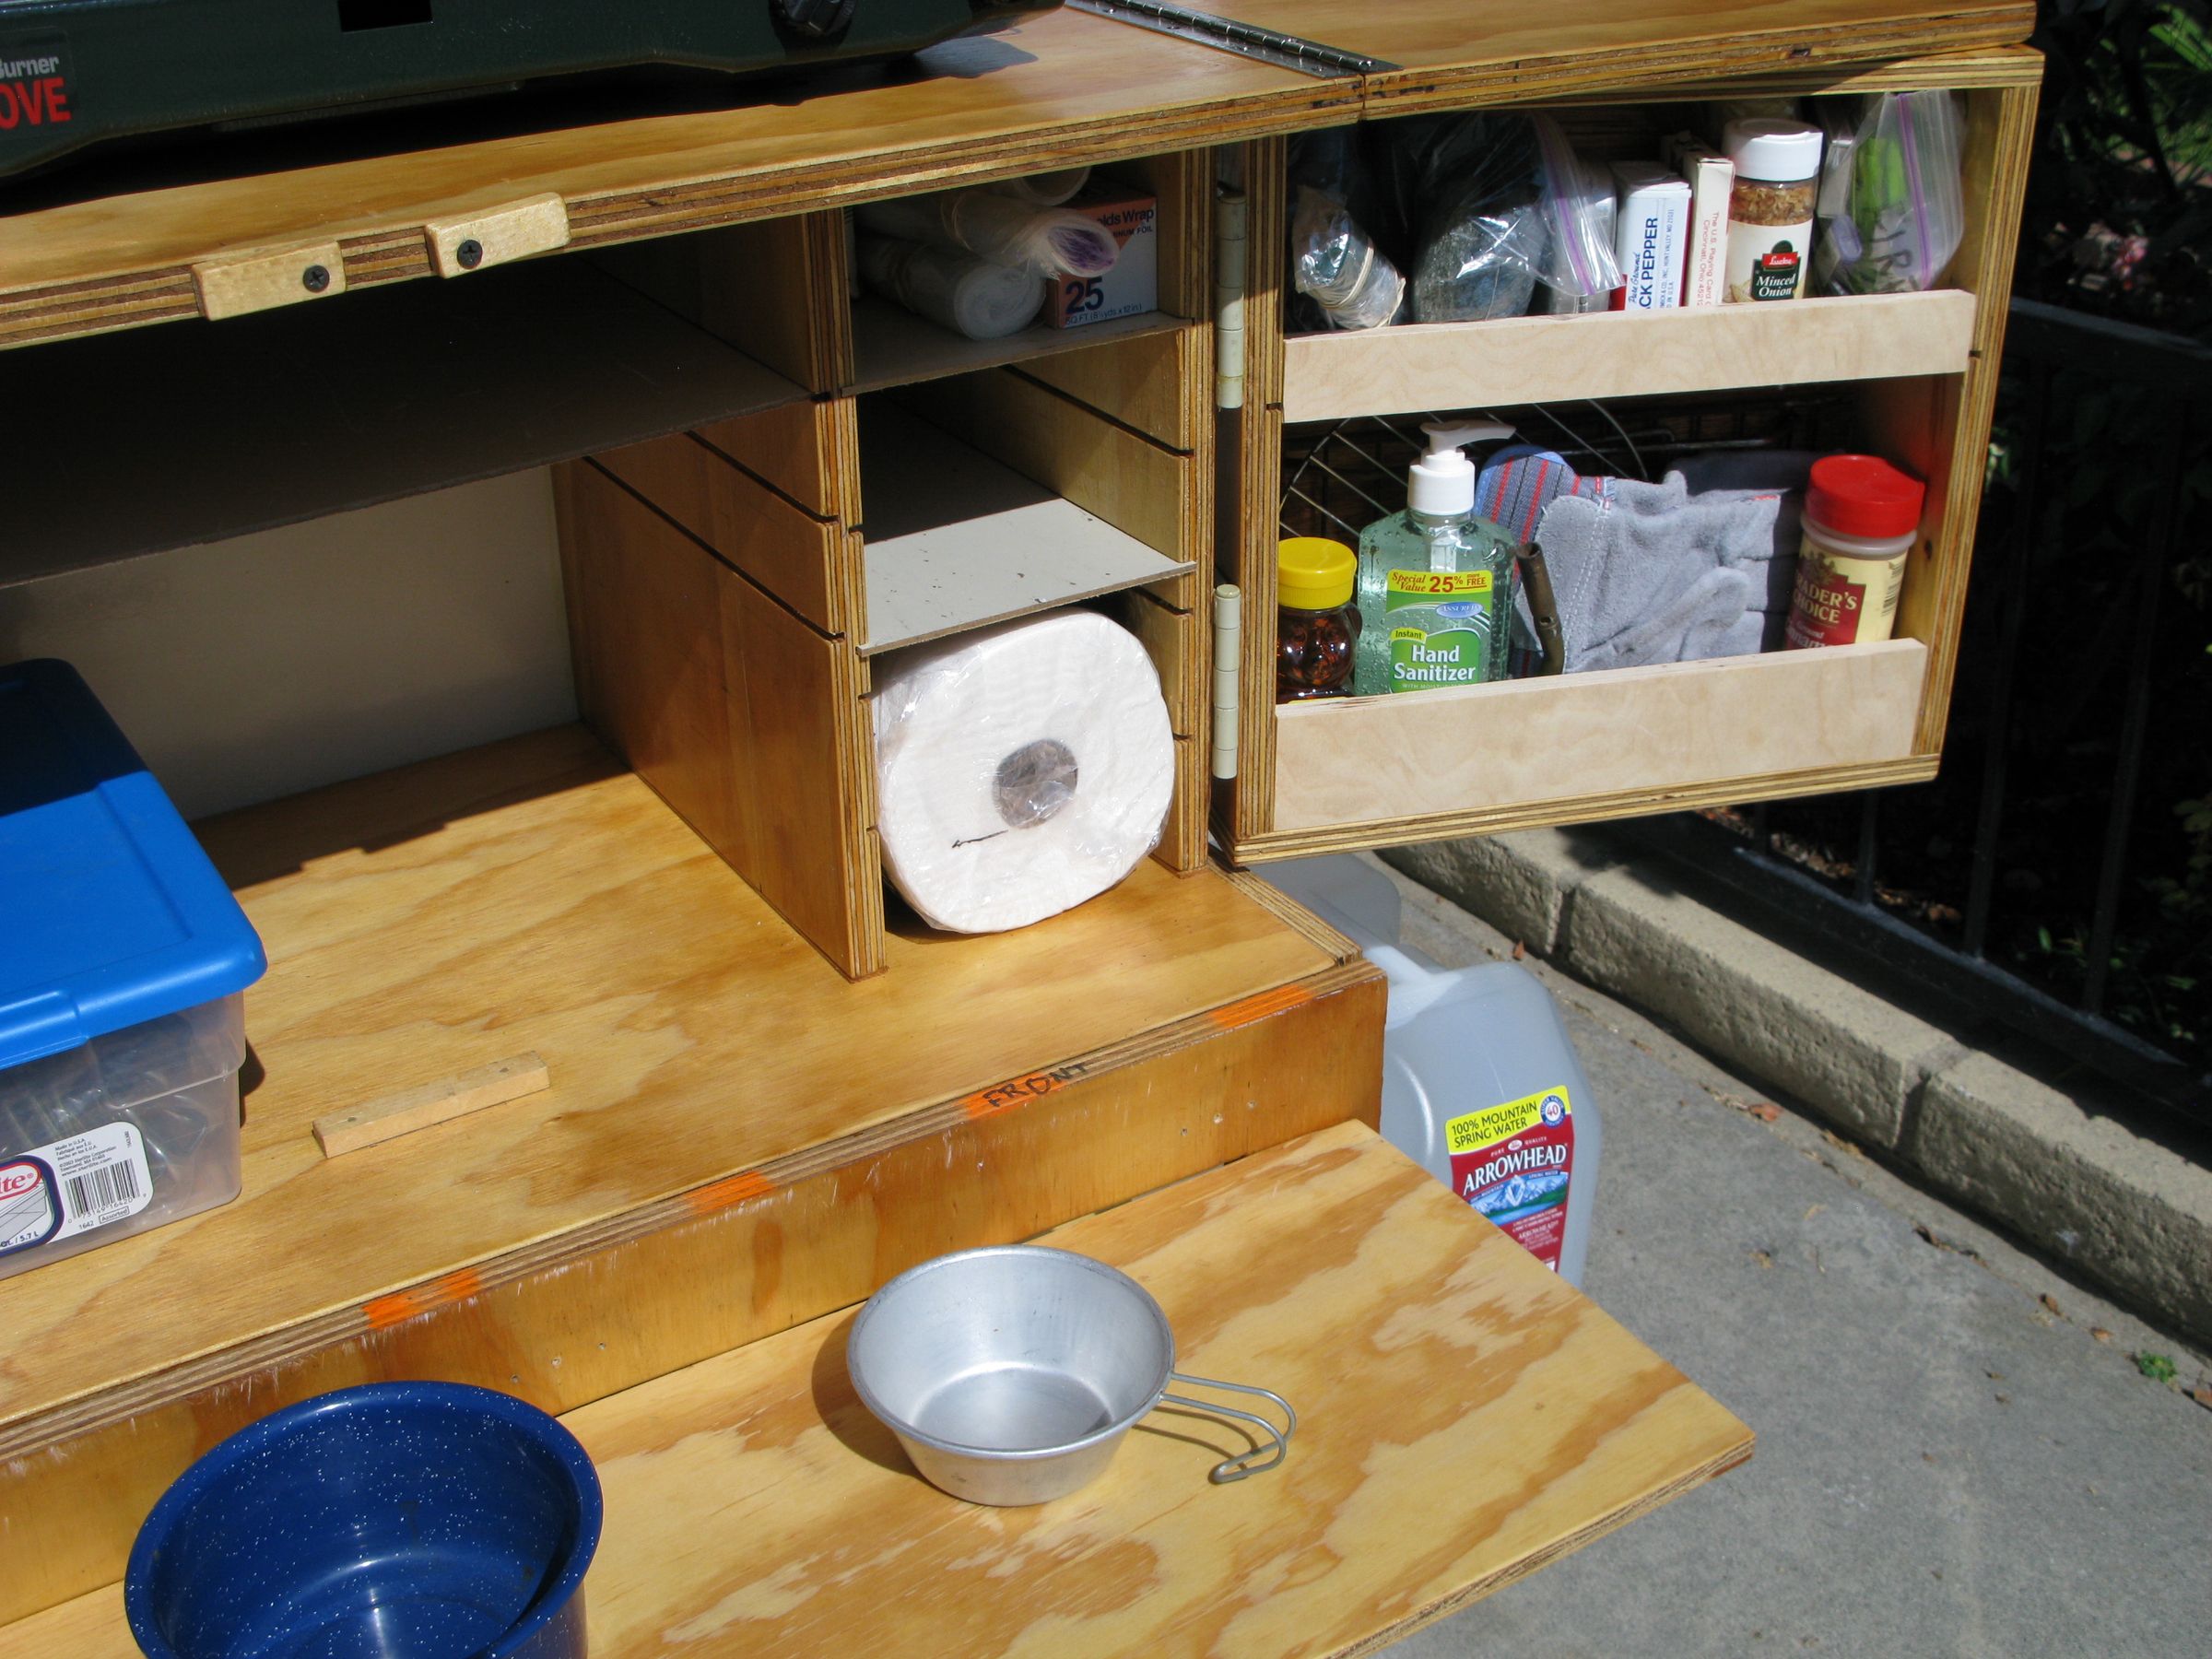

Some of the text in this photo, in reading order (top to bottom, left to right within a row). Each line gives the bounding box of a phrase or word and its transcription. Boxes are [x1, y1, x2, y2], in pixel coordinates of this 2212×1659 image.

[1123, 208, 1154, 222] Wrap
[1712, 211, 1720, 228] The
[1136, 225, 1153, 234] FOIL
[1639, 218, 1658, 309] CK PEPPER
[1706, 248, 1717, 276] Playing
[1698, 263, 1707, 282] Ohio
[1756, 274, 1796, 286] Minced
[1065, 277, 1104, 314] 25
[1705, 277, 1713, 299] Card
[1759, 286, 1793, 297] Onion
[1392, 571, 1426, 584] Special
[1466, 577, 1486, 585] FREE
[1400, 582, 1426, 592] Value
[1795, 571, 1857, 610] RADER'S
[1395, 630, 1422, 639] Instant
[1412, 644, 1460, 662] Hand
[1394, 663, 1476, 681] Sanitizer
[982, 1063, 1088, 1107] FRONT
[1547, 1104, 1559, 1116] 40
[1452, 1119, 1479, 1135] 100%
[1481, 1101, 1537, 1126] MOUNTAIN
[1454, 1127, 1491, 1148] SPRING
[1493, 1116, 1527, 1135] WATER
[1524, 1136, 1547, 1146] QUALITY
[1463, 1144, 1567, 1197] ARROWHEAD
[101, 1208, 128, 1222] Assorted
[78, 1221, 94, 1230] 1642
[19, 1232, 31, 1241] 5.7
